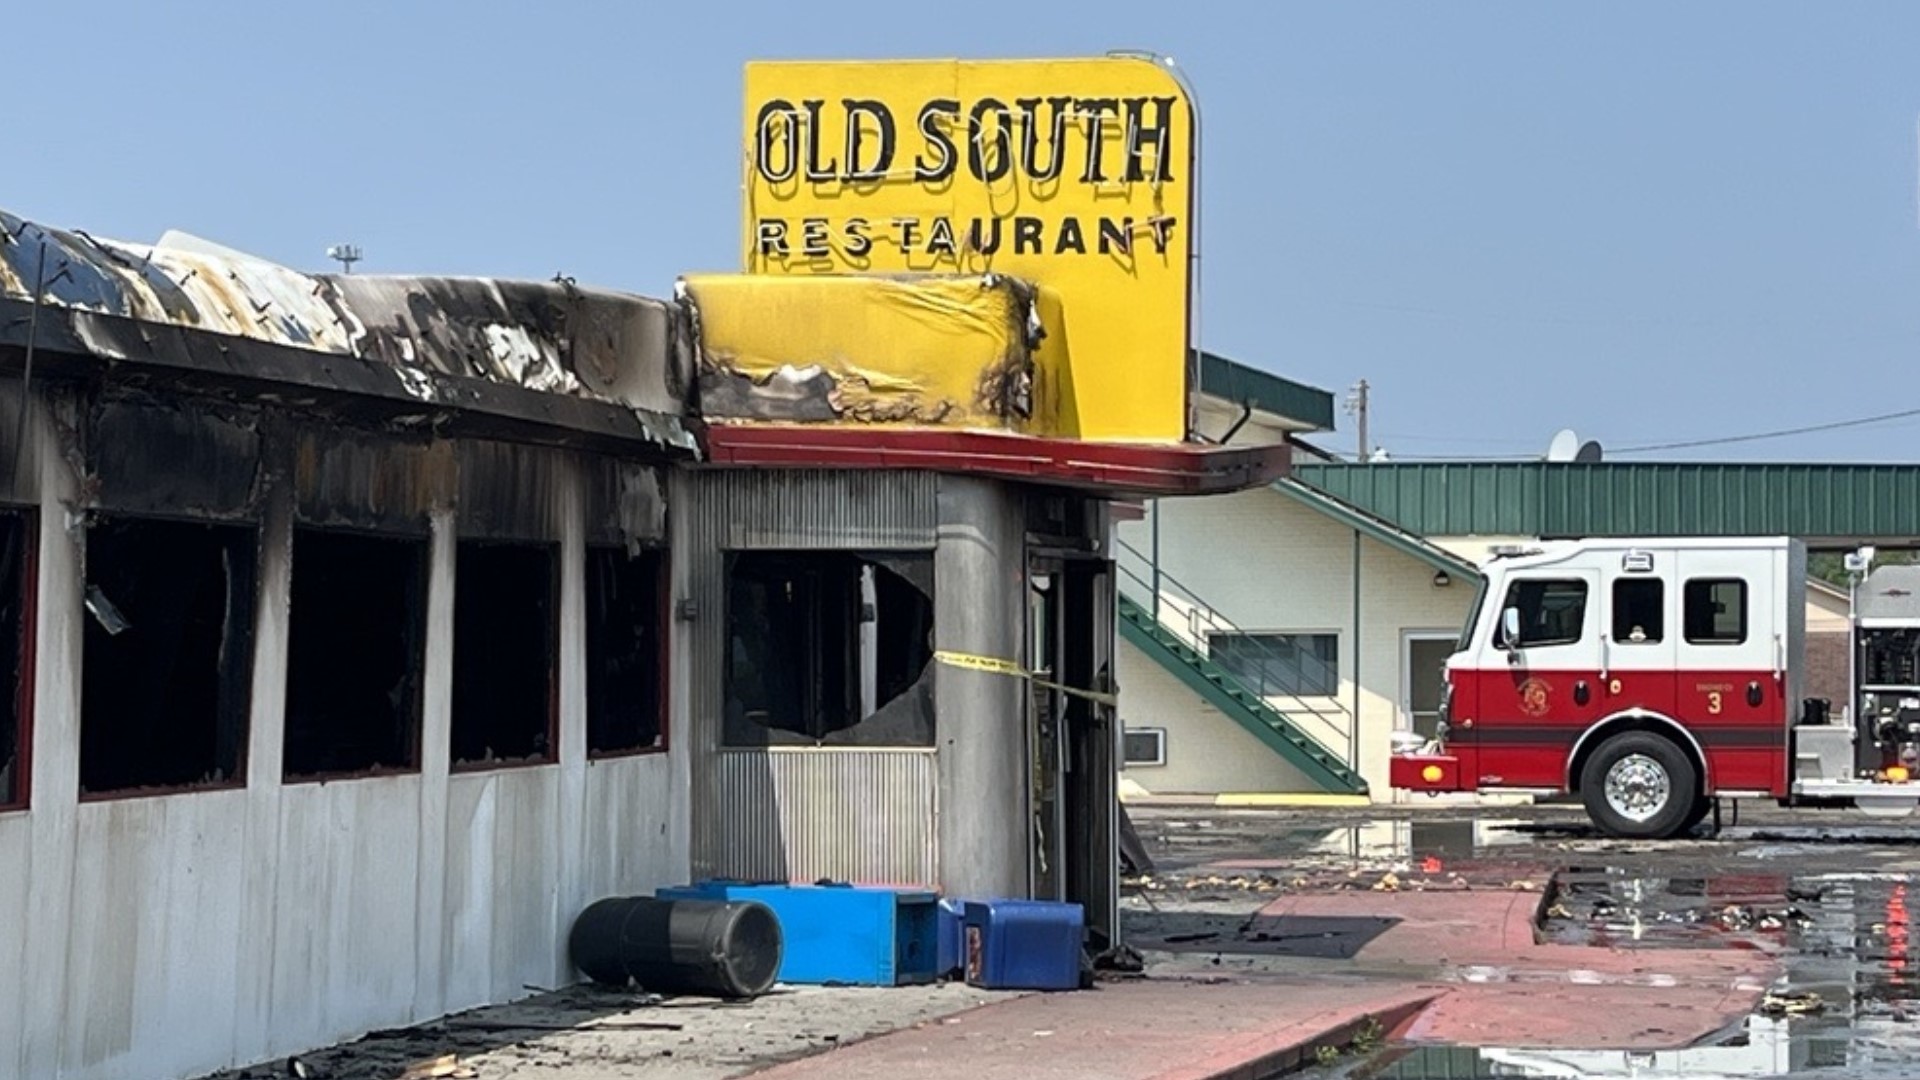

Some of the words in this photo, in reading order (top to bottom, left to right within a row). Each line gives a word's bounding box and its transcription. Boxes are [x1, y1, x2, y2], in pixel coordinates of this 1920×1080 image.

[757, 99, 896, 183] OLD
[915, 97, 1177, 184] SOUTH
[757, 217, 1177, 256] RESTAURANT
[1708, 692, 1721, 714] 3
